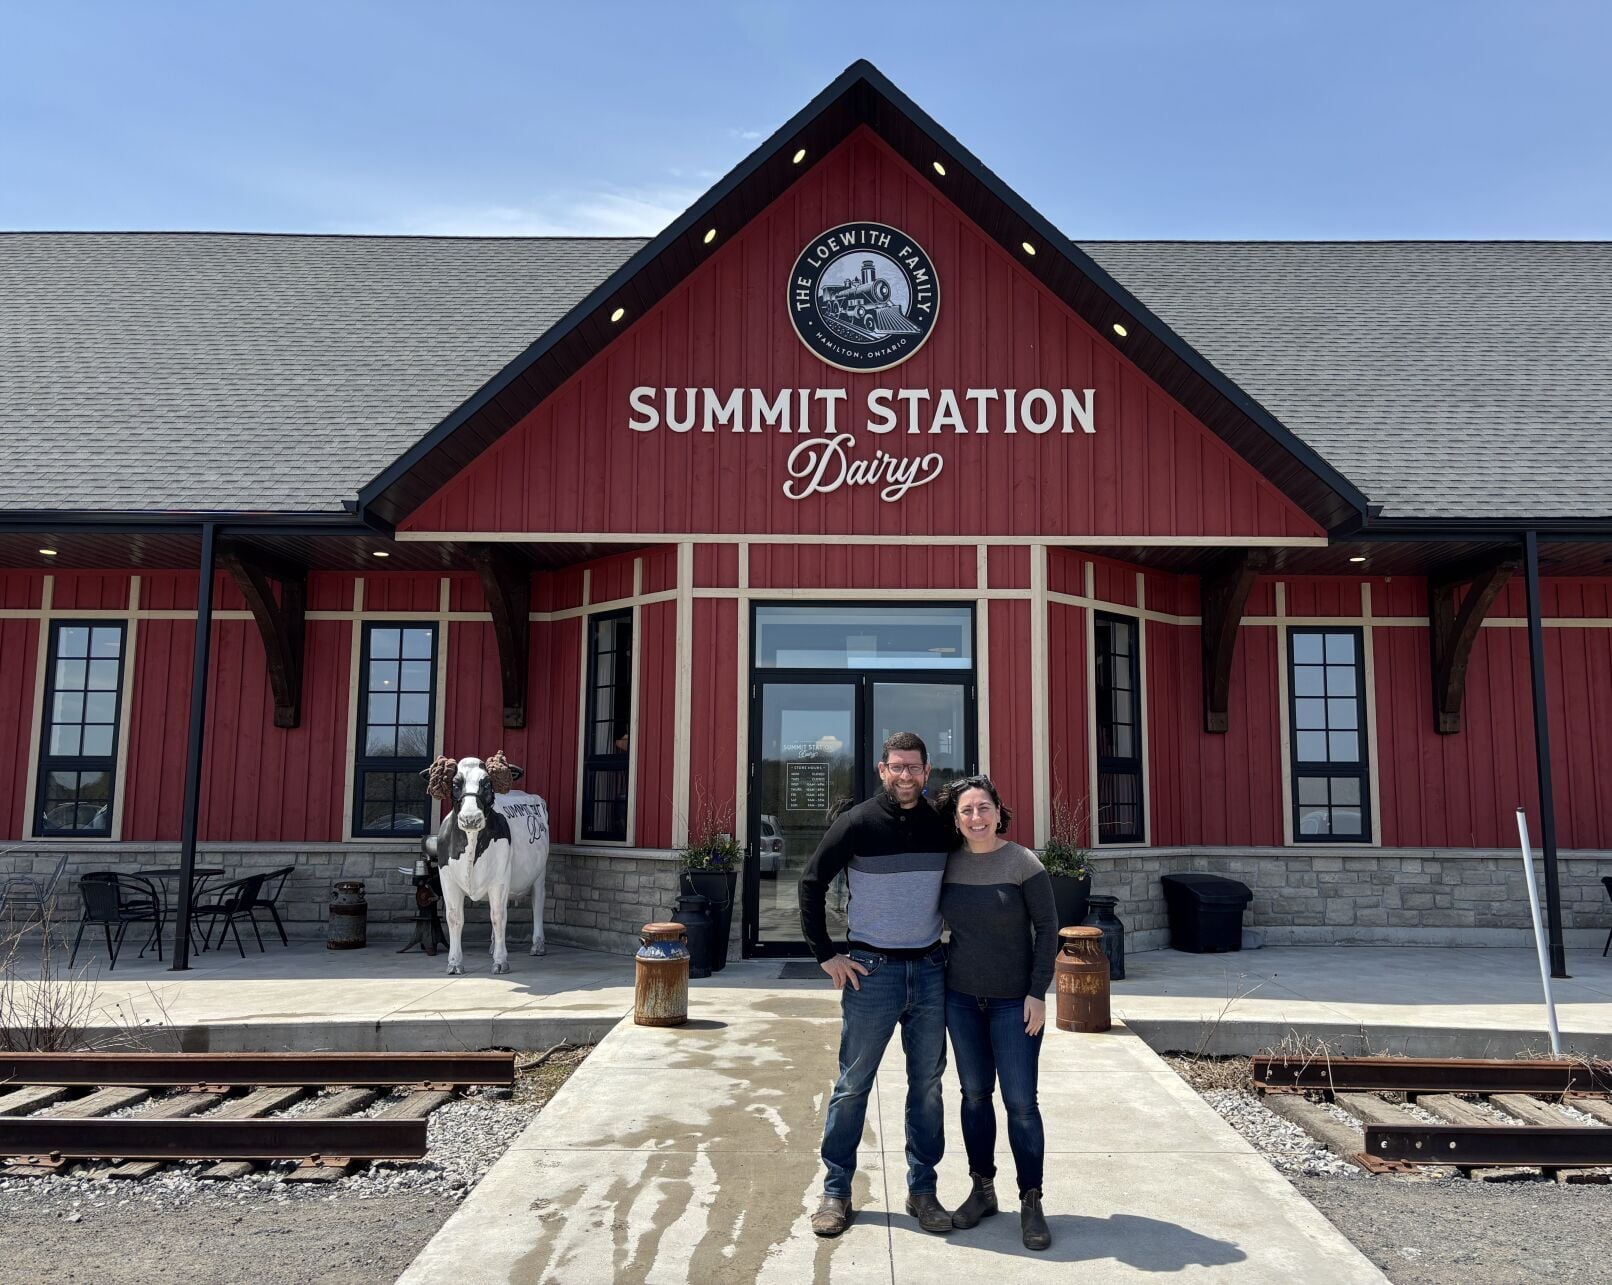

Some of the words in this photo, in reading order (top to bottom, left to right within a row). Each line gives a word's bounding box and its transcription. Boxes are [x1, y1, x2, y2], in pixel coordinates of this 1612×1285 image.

[795, 277, 812, 312] THE
[807, 230, 892, 268] LOEWITH
[898, 246, 932, 313] FAMILY
[815, 331, 864, 359] HAMILTON,
[867, 338, 907, 359] ONTARIO
[628, 386, 848, 434] SUMMIT
[866, 387, 1097, 434] STATION
[782, 433, 944, 502] Dairy
